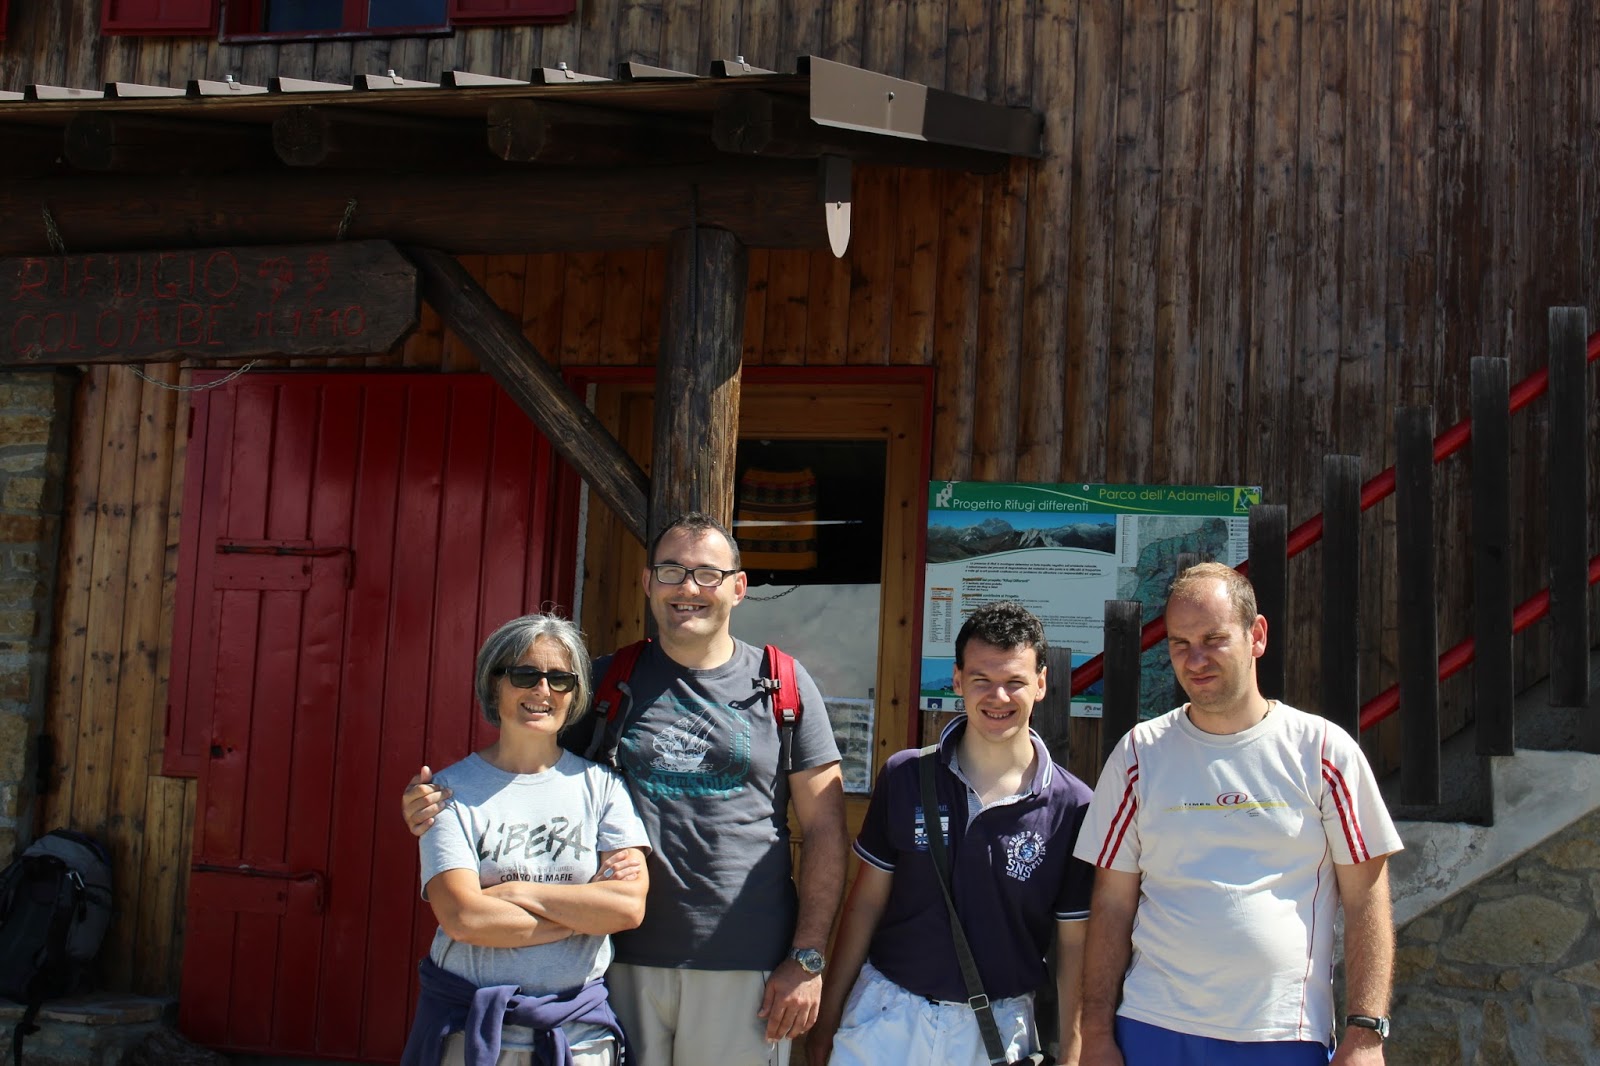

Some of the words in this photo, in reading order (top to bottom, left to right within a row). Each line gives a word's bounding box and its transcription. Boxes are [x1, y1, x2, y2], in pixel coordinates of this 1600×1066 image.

[9, 251, 240, 301] RIFUGIO
[292, 305, 366, 337] 1710
[1098, 488, 1137, 501] Parco
[953, 499, 1002, 512] Progetto
[1004, 499, 1036, 513] Rifugi
[1037, 500, 1089, 512] differenti
[1006, 858, 1033, 879] SNS
[500, 872, 531, 882] CONRO
[533, 874, 543, 883] LE
[545, 872, 573, 882] MAFIE
